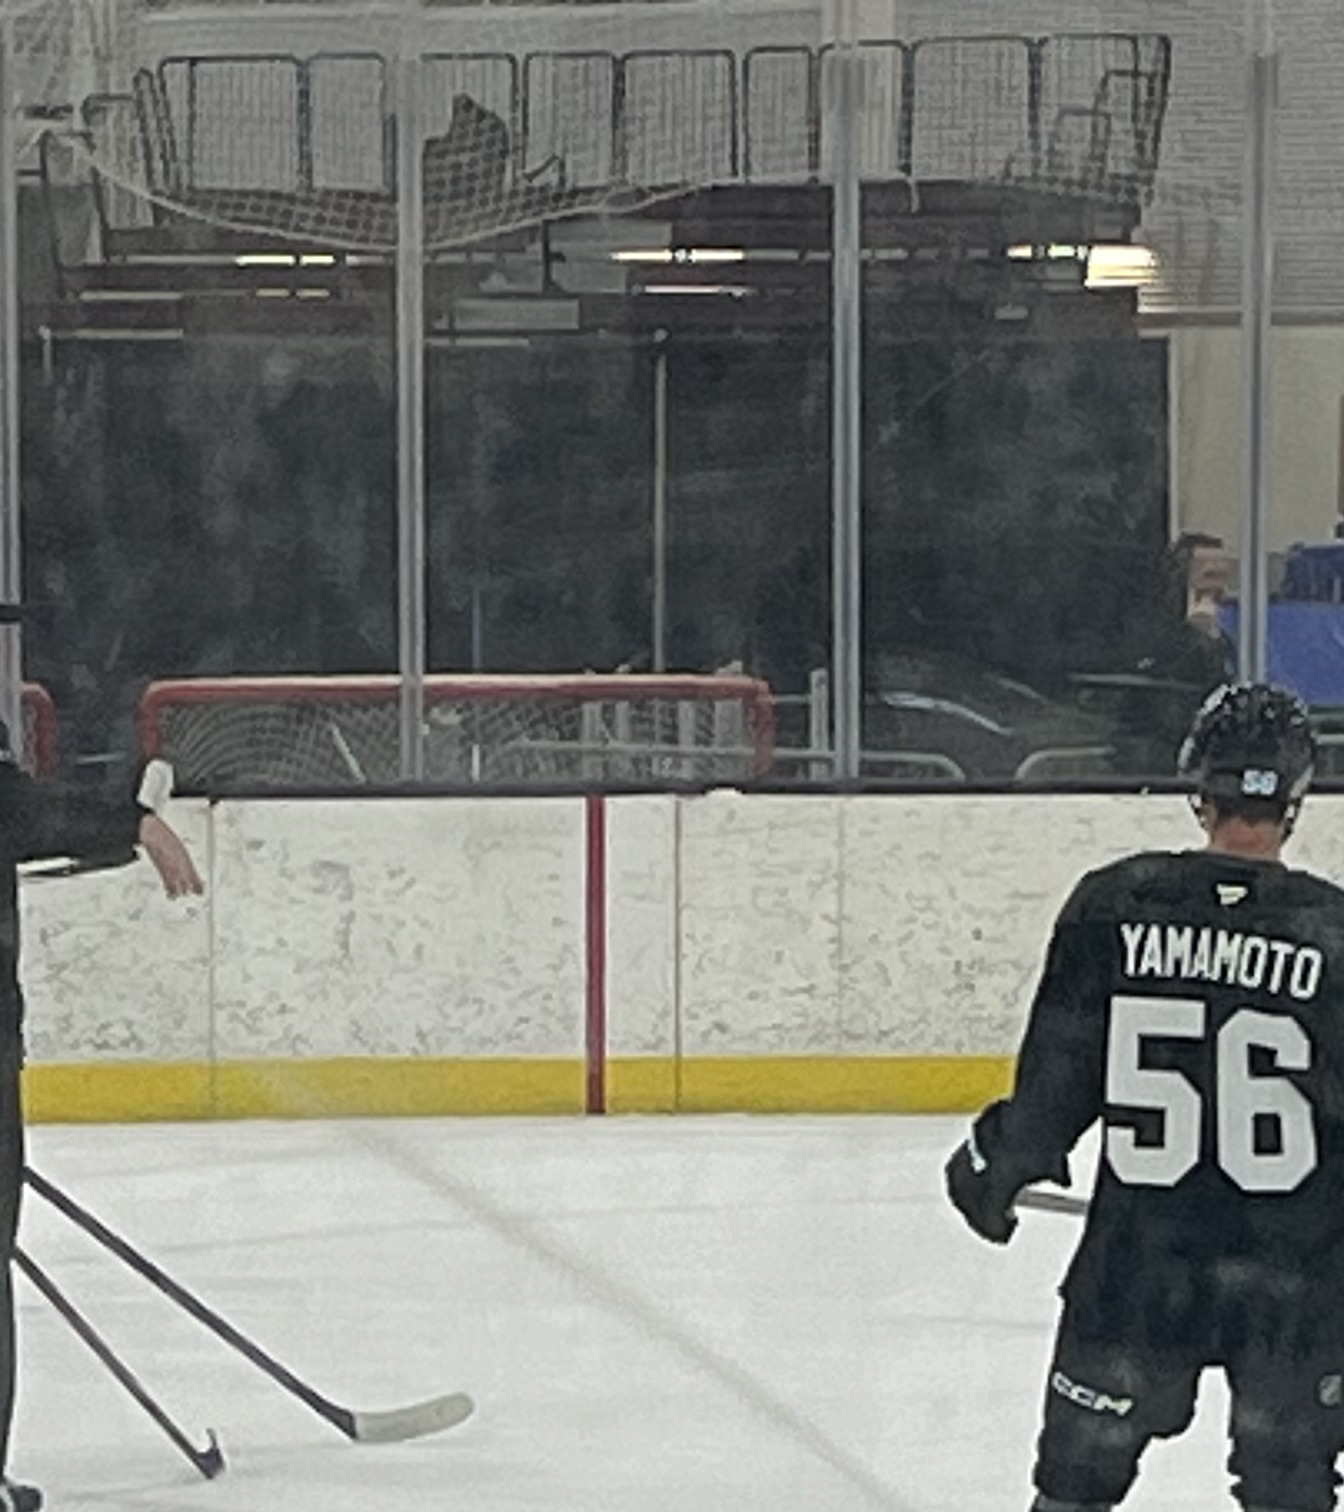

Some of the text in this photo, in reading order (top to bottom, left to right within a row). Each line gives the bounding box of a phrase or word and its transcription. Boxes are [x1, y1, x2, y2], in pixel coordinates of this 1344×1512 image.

[1120, 922, 1323, 1000] YAMAMOTO
[1106, 995, 1319, 1192] 56
[1051, 1371, 1133, 1417] CCM
